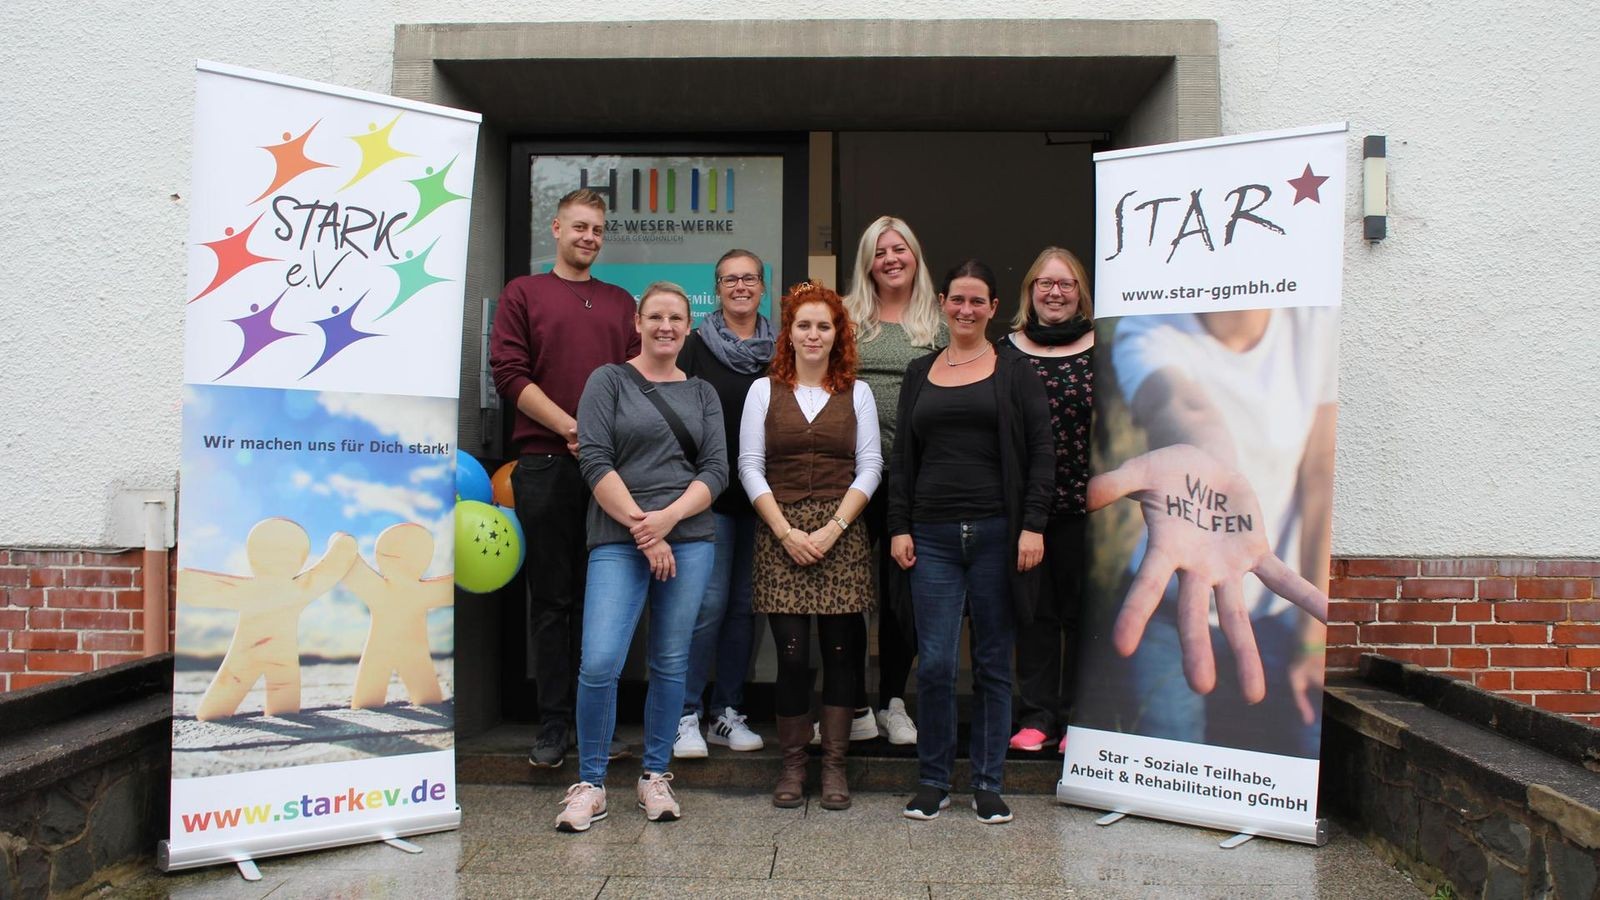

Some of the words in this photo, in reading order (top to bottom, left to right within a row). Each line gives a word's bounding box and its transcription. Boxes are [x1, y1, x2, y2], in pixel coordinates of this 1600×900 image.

[272, 195, 408, 260] STARK
[604, 219, 734, 232] RZ-WESER-WERKE
[1105, 183, 1286, 264] STAR
[286, 250, 352, 292] e.V.
[1122, 278, 1297, 302] www.star-ggmbh.de
[203, 435, 234, 449] Wir
[240, 437, 302, 451] machen
[308, 440, 336, 452] uns
[341, 439, 364, 453] für
[370, 440, 403, 454] Dich
[408, 443, 449, 455] stark!
[1166, 494, 1253, 533] HELFEN
[1186, 473, 1228, 513] WIR
[1070, 763, 1115, 782] Arbeit
[1118, 770, 1129, 783] &
[1134, 773, 1243, 802] Rehabilitation
[1248, 793, 1308, 812] gGmbH
[1098, 749, 1129, 765] Star
[1144, 756, 1199, 776] Soziale
[1203, 765, 1277, 790] Teilhabe,
[181, 779, 446, 833] www.starkev.de
